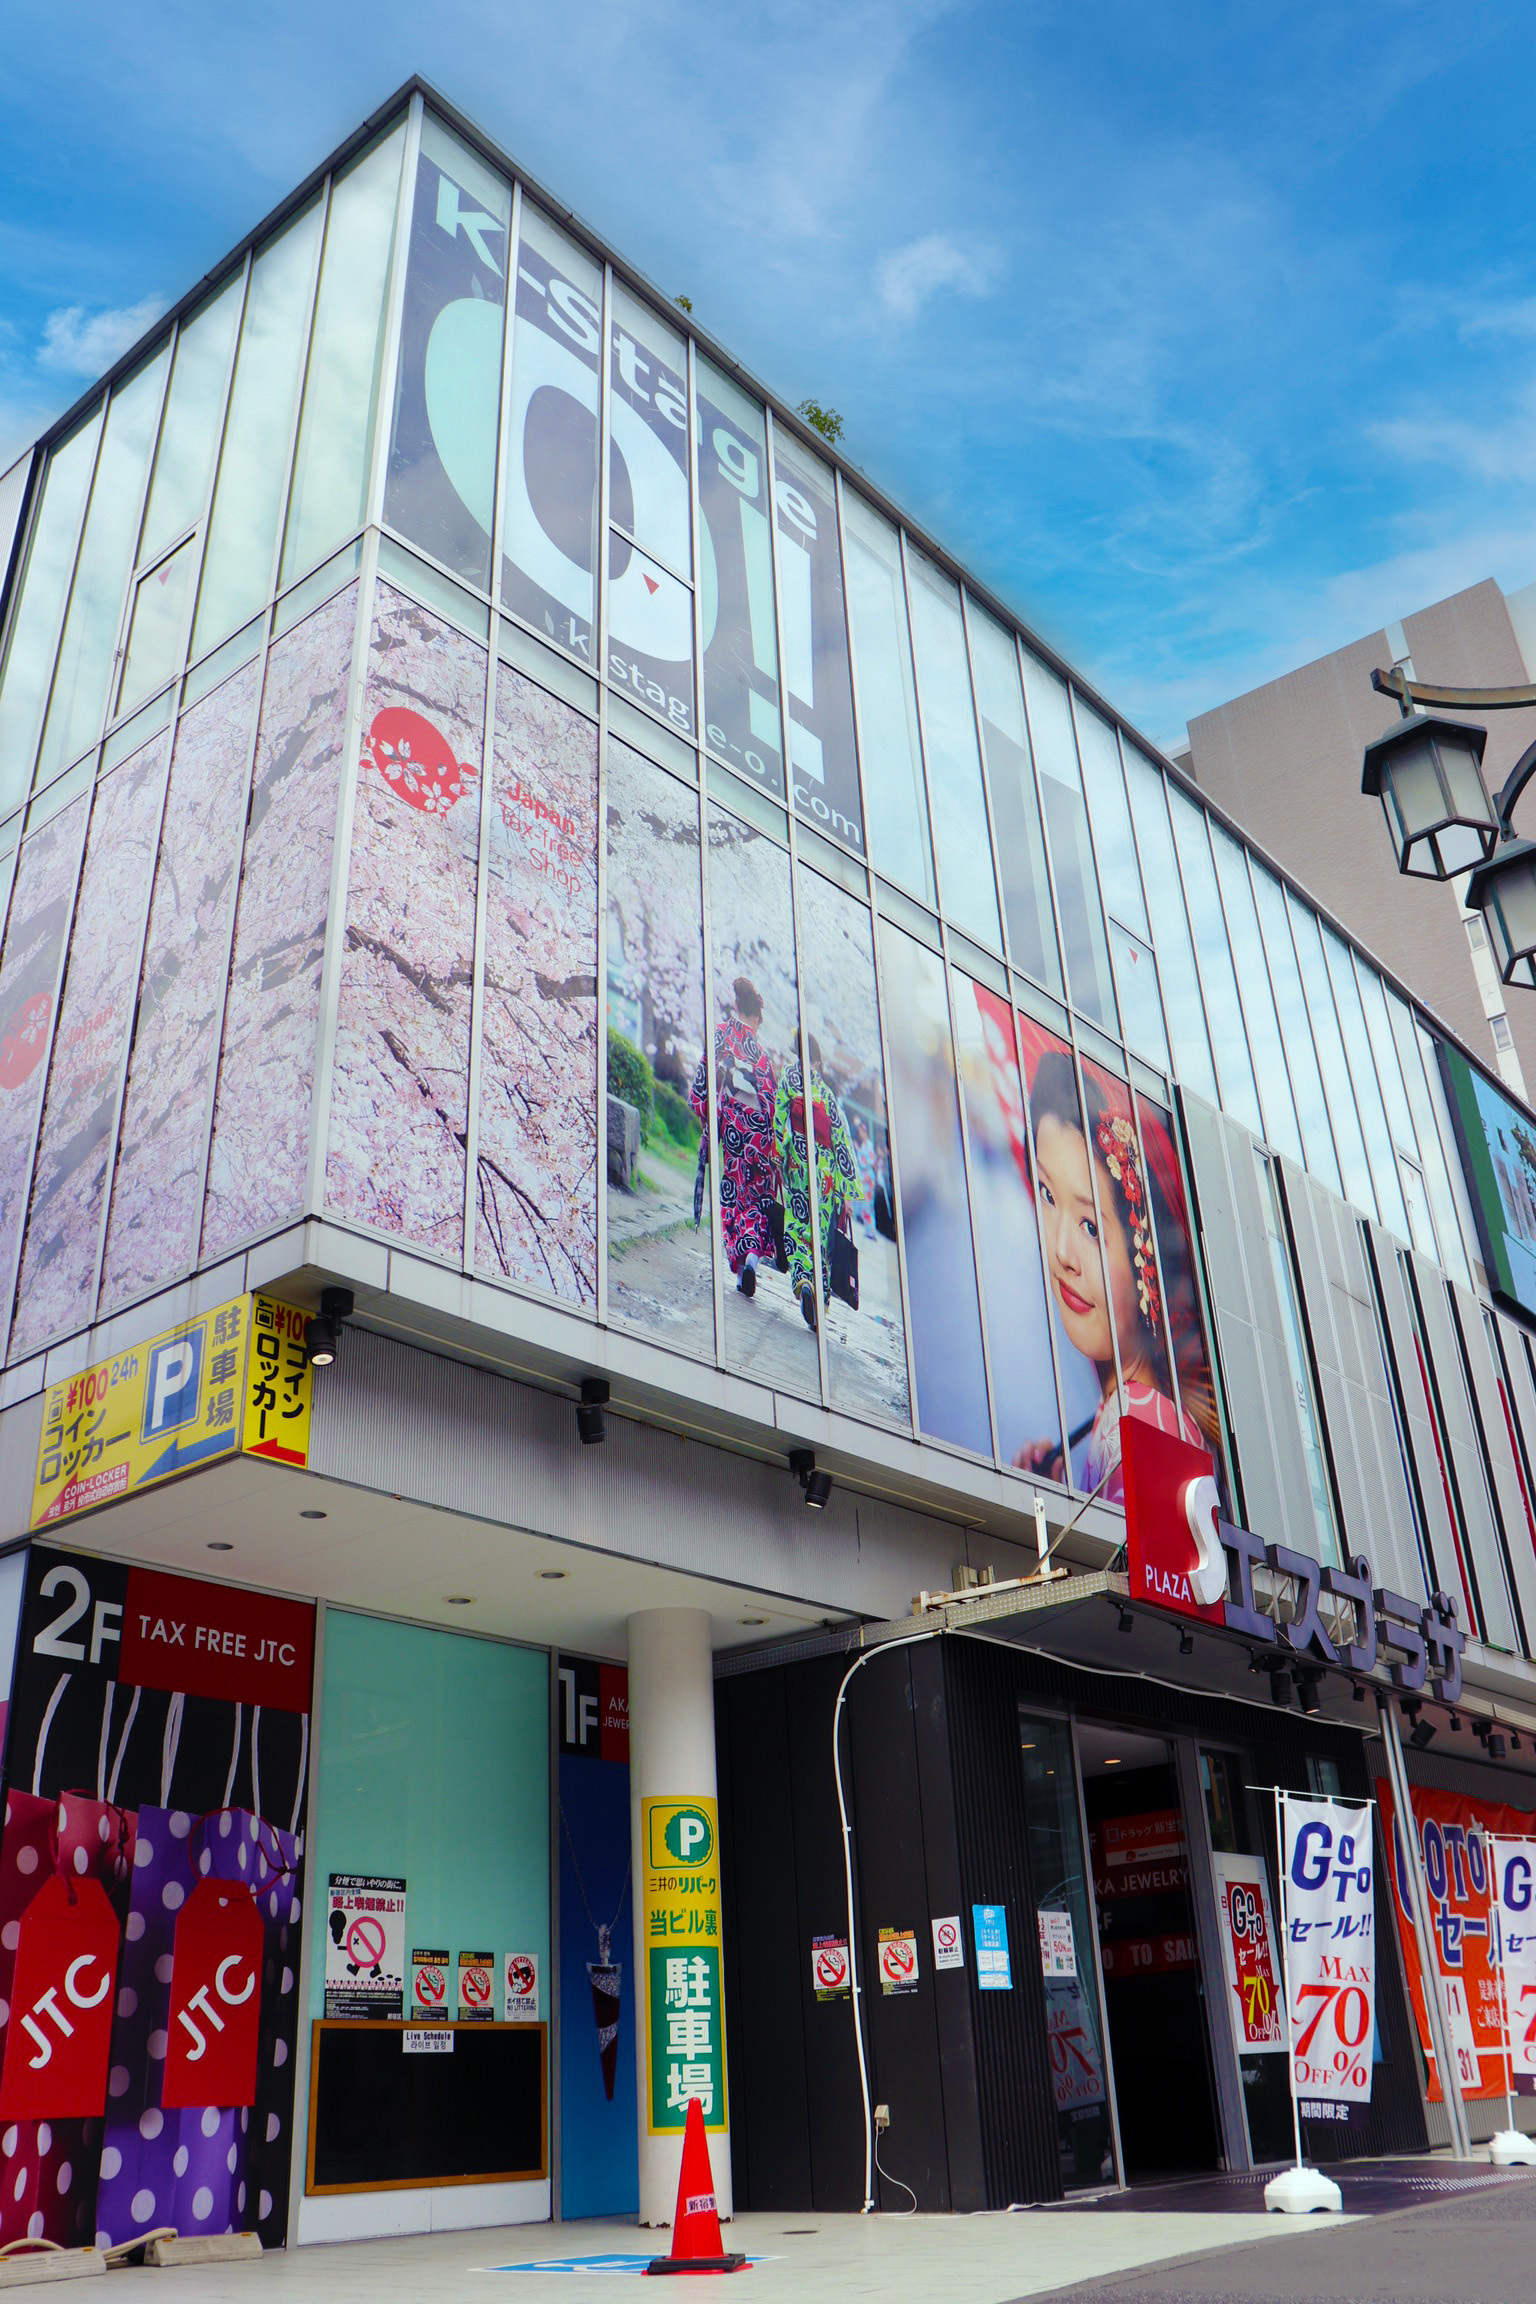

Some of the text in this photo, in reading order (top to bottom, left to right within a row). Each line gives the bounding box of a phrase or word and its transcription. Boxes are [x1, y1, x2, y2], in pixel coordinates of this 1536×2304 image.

[500, 802, 581, 868] Tax-free
[529, 848, 581, 895] Shop
[66, 1354, 139, 1414] ¥100 24h
[151, 1341, 193, 1430] P
[206, 1305, 241, 1428] 駐車場
[252, 1332, 279, 1439] ロッカー
[282, 1342, 308, 1419] コイン
[44, 1407, 107, 1454] コイン
[40, 1431, 131, 1485] ロッカー
[64, 1464, 127, 1500] COIN-LOCKER
[1145, 1563, 1192, 1604] PLAZA
[33, 1565, 296, 1667] 2F TAX FREE JTC
[1217, 1517, 1466, 1703] エスプラザ
[558, 1667, 598, 1745] 1F
[680, 1817, 705, 1856] P
[650, 1875, 716, 1894] 三井のリパーク
[1121, 1867, 1189, 1892] JEWELRY
[650, 1908, 718, 1936] 当ビル裏
[1290, 1913, 1371, 1943] セール!!
[1129, 1943, 1152, 1967] TO
[1164, 1938, 1200, 1963] SAL
[1238, 1940, 1269, 1966] セール!!
[20, 1954, 111, 2069] JTC
[177, 1954, 255, 2061] JTC
[406, 2031, 451, 2040] Live Schedule
[411, 2041, 431, 2050] 라이브
[665, 1955, 714, 2115] 駐車場
[1458, 2047, 1475, 2082] 31
[1300, 2102, 1349, 2121] 期間限定
